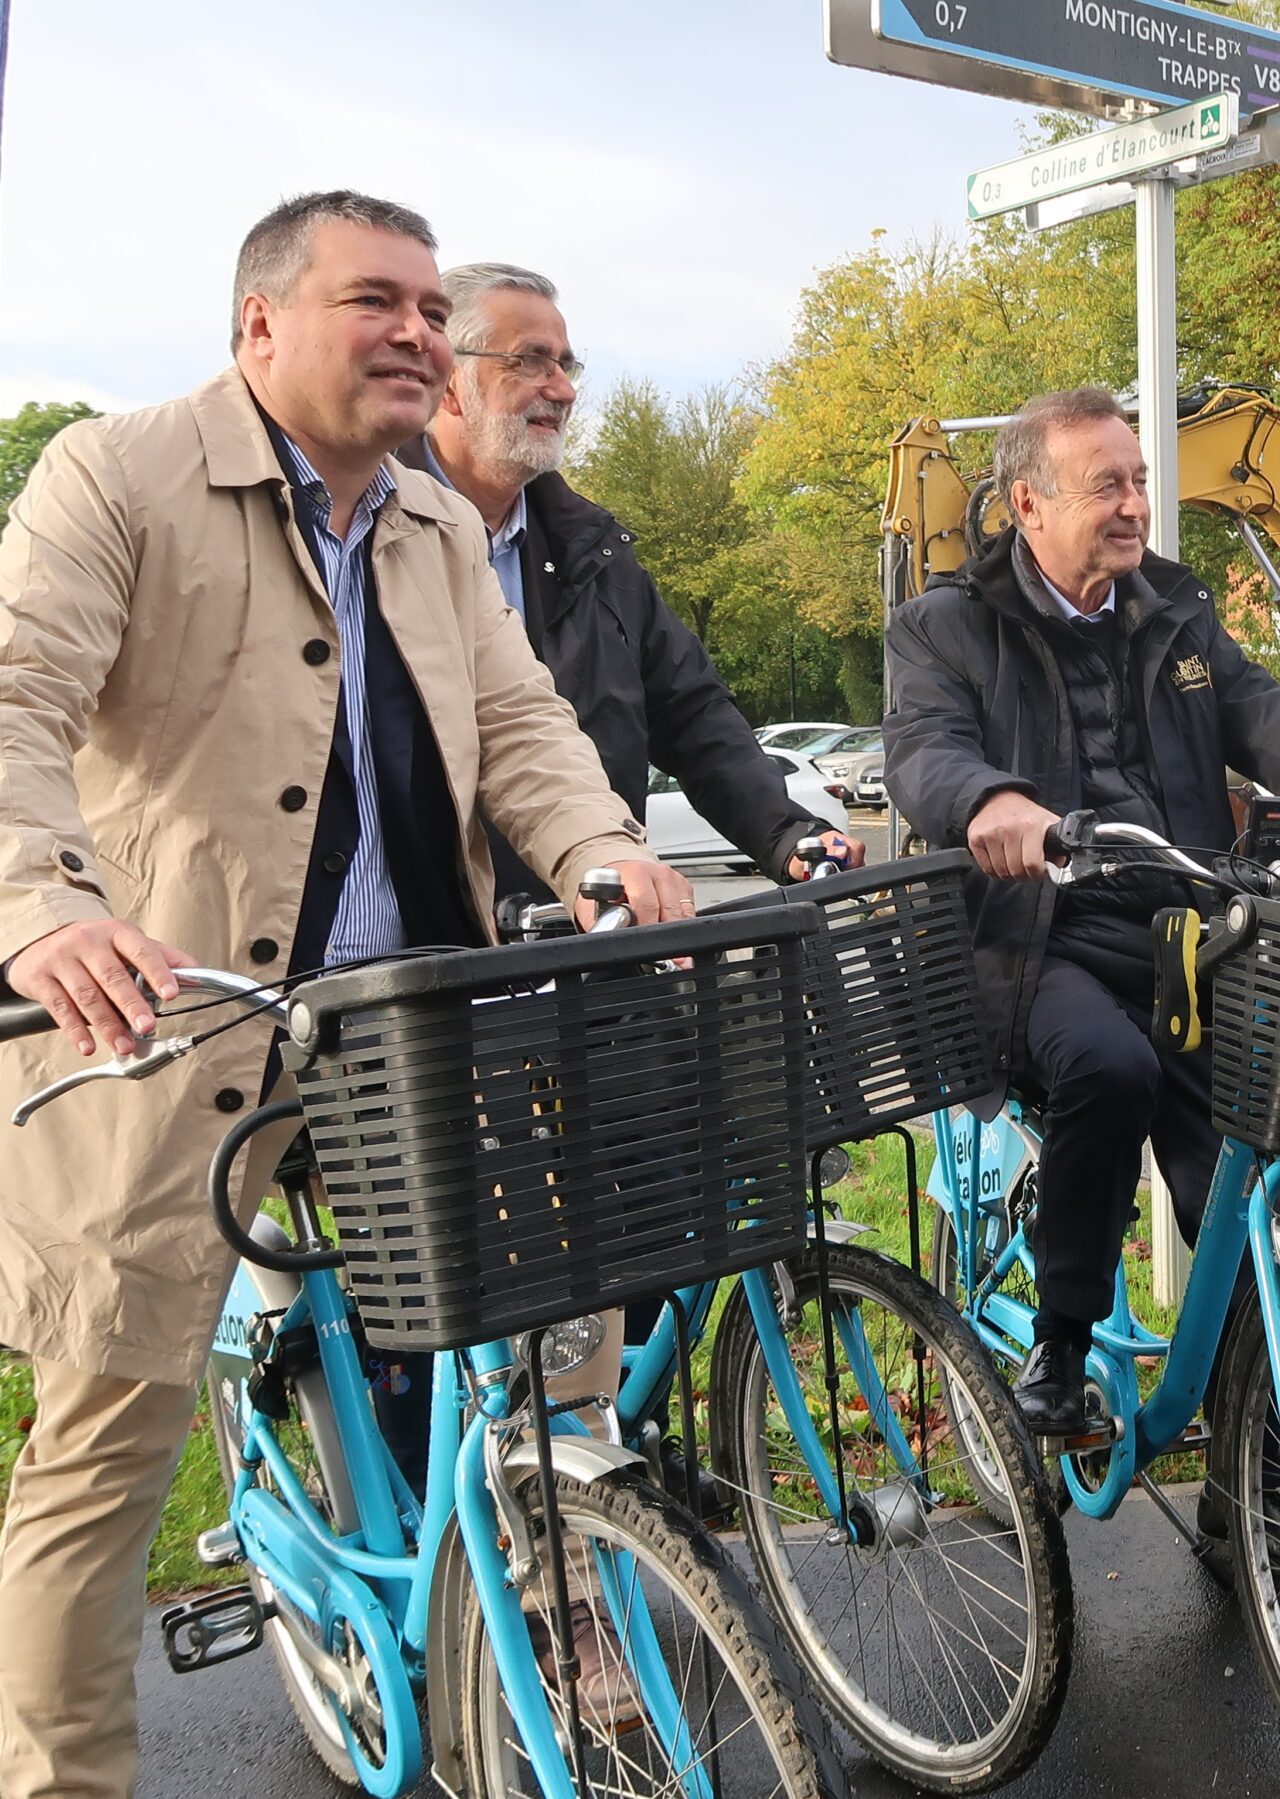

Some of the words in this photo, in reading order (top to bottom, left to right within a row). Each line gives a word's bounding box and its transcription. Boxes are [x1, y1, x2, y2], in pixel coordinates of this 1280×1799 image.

[935, 0, 967, 33] 0,7
[1157, 56, 1242, 98] TRAPPES
[1031, 155, 1087, 188] Colline
[1095, 118, 1196, 168] d'Élancourt
[320, 1318, 350, 1339] 110
